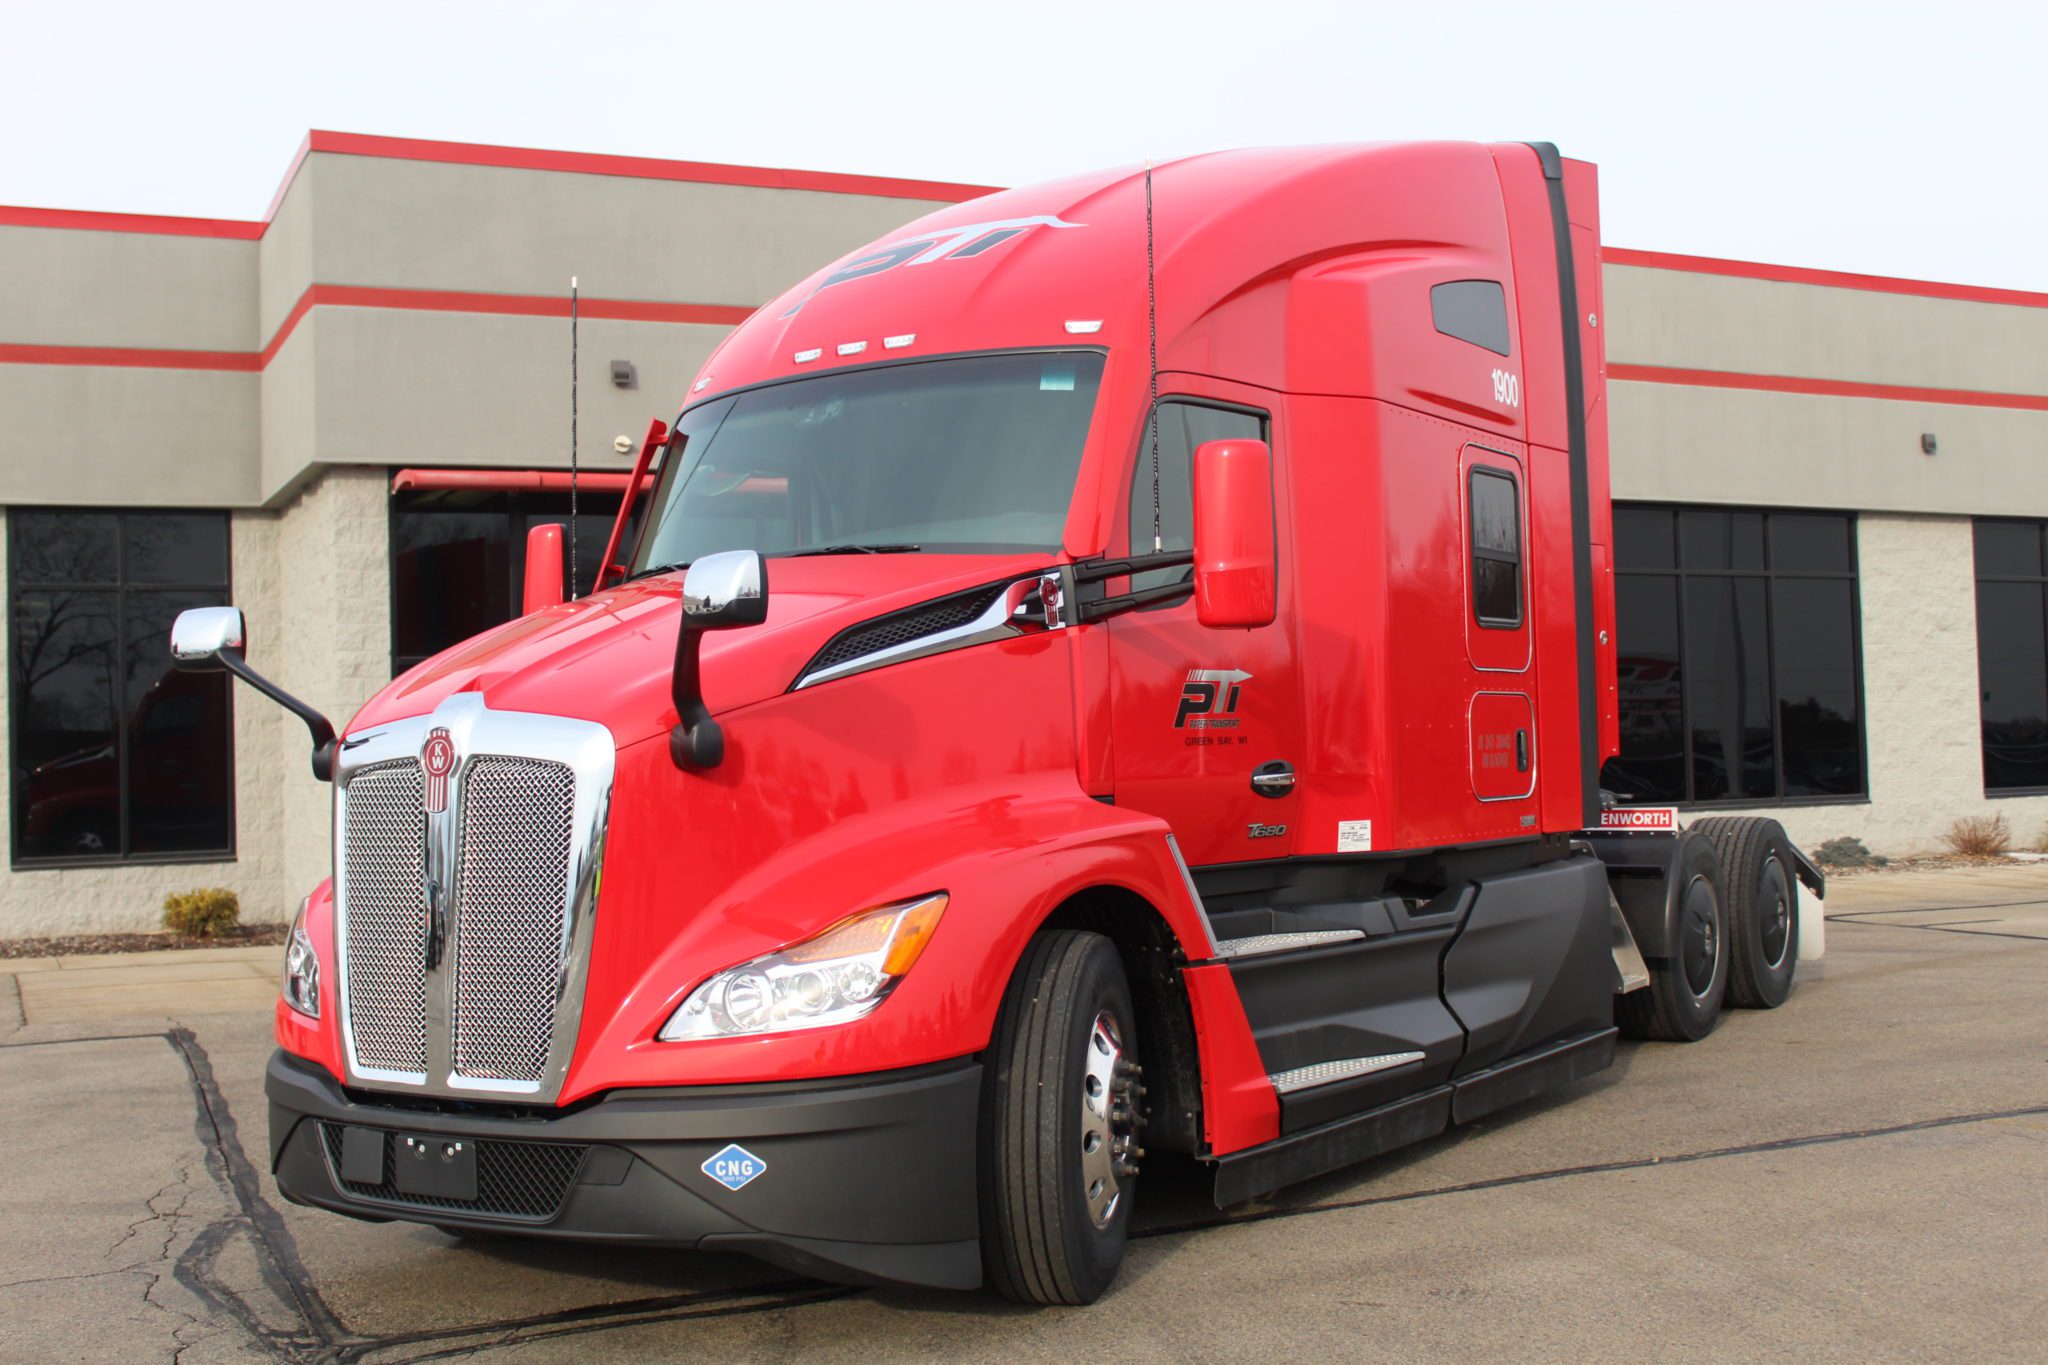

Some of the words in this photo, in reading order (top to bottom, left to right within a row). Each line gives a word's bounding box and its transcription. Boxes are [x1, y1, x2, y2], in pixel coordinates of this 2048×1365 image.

[1491, 368, 1519, 408] 1900
[1184, 737, 1214, 746] GREEN
[1238, 736, 1248, 745] WI
[1600, 812, 1670, 825] ENWORTH
[1247, 823, 1288, 838] T680
[715, 1160, 754, 1177] CNG
